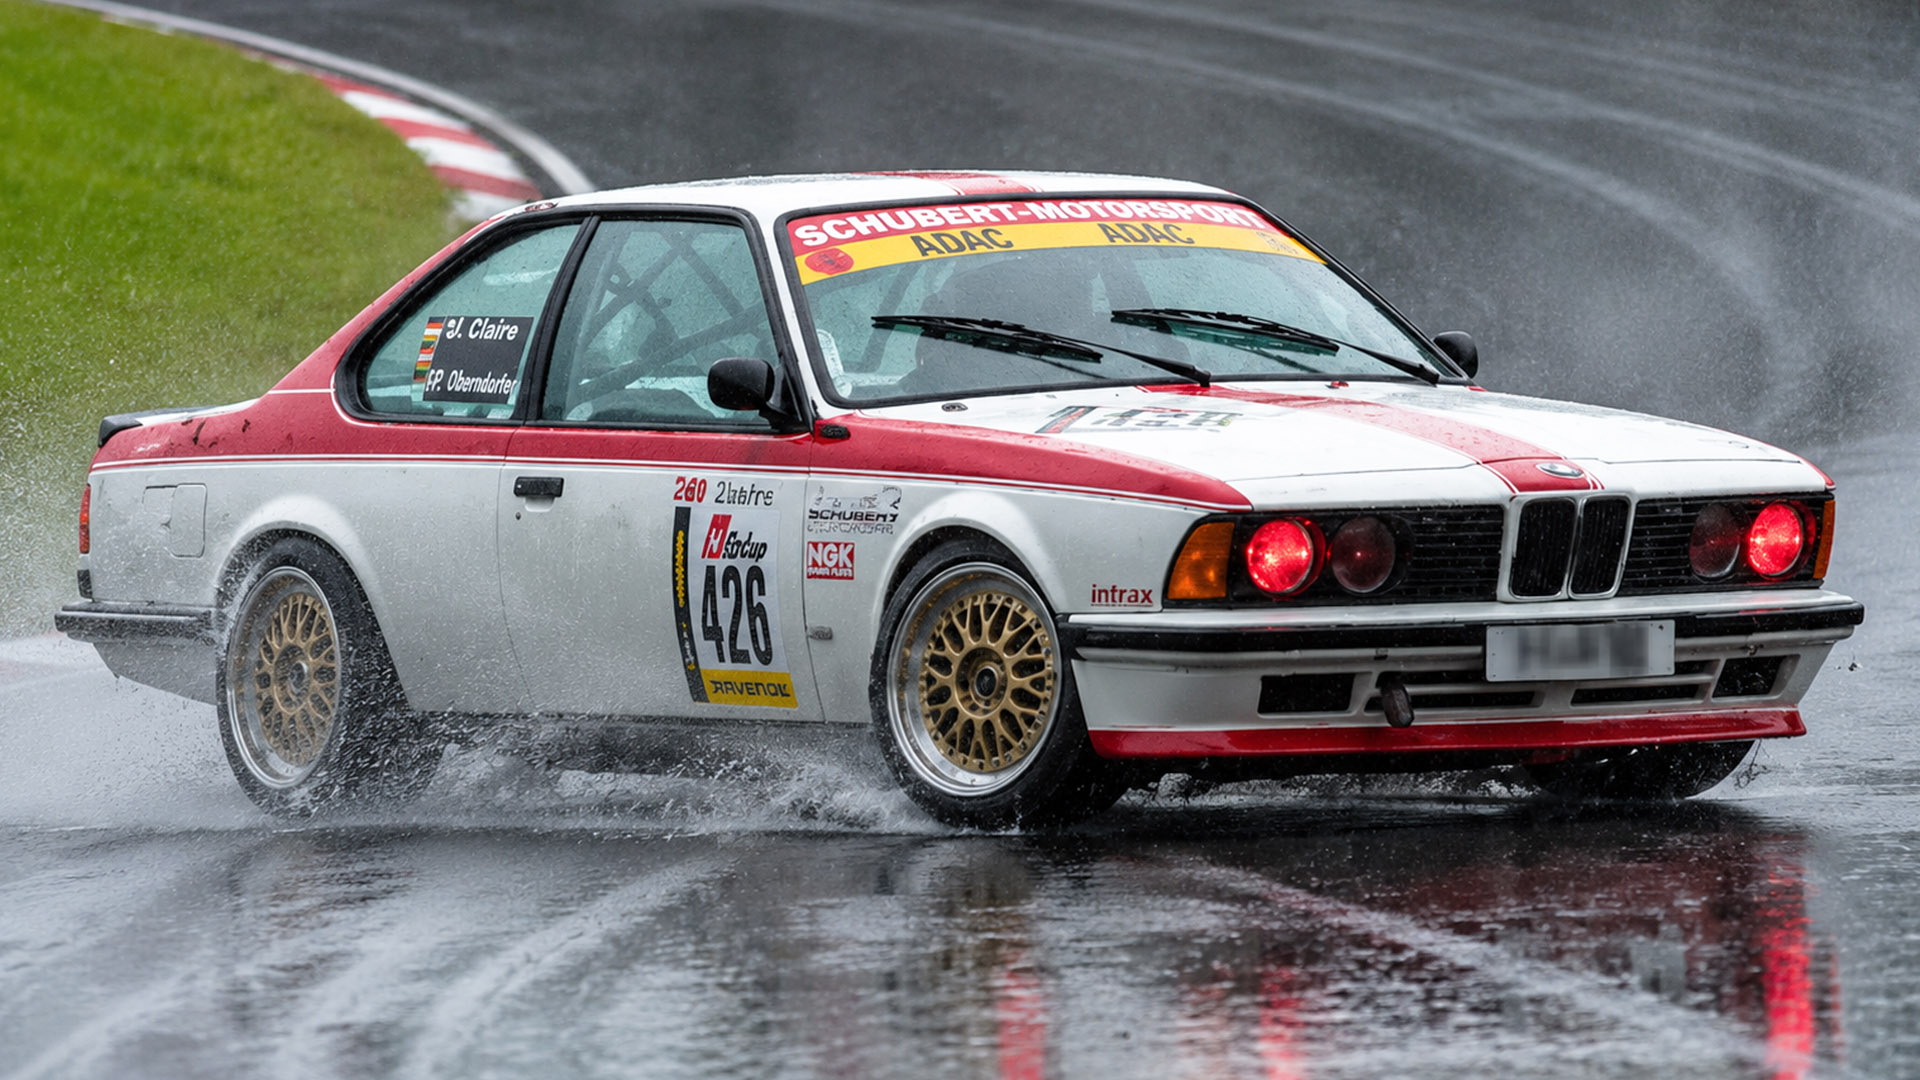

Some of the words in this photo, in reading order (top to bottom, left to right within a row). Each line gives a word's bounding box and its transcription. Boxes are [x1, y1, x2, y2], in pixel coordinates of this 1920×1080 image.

[910, 228, 1014, 256] ADAC
[1097, 223, 1195, 245] ADAC
[468, 318, 519, 340] Claire
[807, 543, 854, 568] NGK
[1091, 584, 1153, 604] intrax
[701, 565, 773, 666] 426
